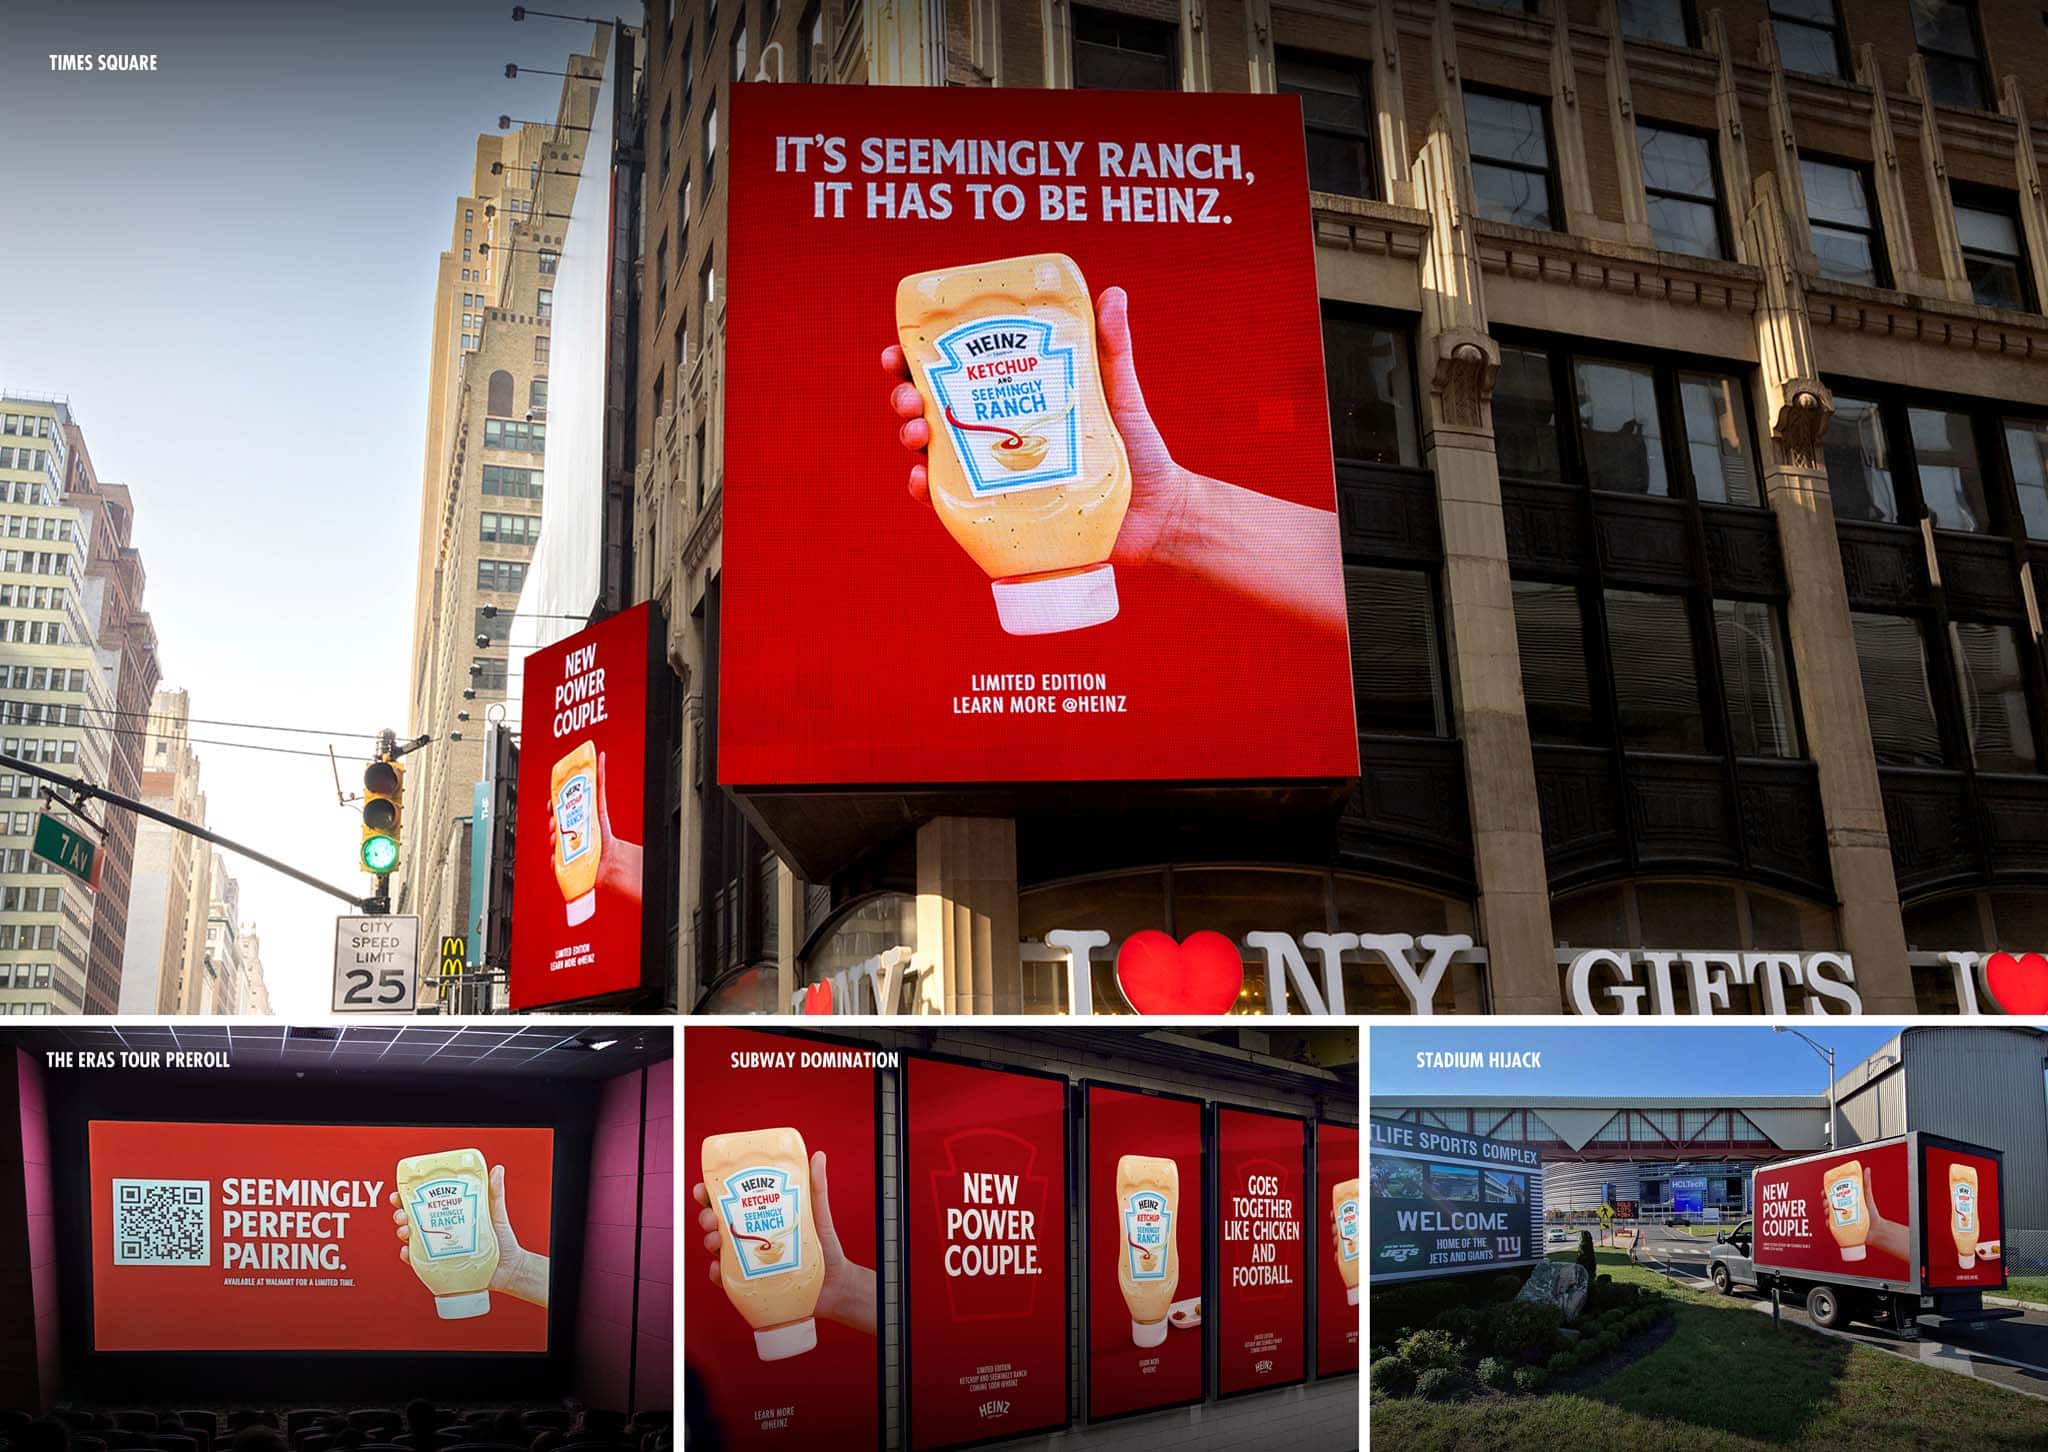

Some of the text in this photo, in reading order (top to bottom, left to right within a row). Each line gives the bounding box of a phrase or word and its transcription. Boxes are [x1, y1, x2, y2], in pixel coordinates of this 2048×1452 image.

[860, 136, 1084, 177] SEEMINGLY
[1099, 142, 1255, 185] RANCH,
[813, 181, 1233, 224] IT HAS TO BE HEINZ.
[965, 333, 1028, 357] HEINZ
[966, 356, 1039, 381] KETCHUP
[971, 379, 1043, 401] SEEMINGLY
[997, 376, 1013, 385] AND
[974, 393, 1048, 421] RANCH
[564, 642, 598, 680] NEW
[554, 667, 606, 712] POWER
[971, 673, 1106, 692] LIMITED EDITION
[953, 695, 1127, 714] LEARN MORE @HEINZ
[552, 695, 609, 739] COUPLE.
[60, 832, 89, 873] 7 AV
[360, 922, 393, 933] CITY
[351, 937, 400, 949] SPEED
[355, 952, 394, 964] LIMIT
[1246, 931, 1473, 1015] NY
[1567, 949, 1863, 1015] GIFTS
[343, 969, 406, 1005] 25
[1419, 1131, 1478, 1157] SPORTS
[1482, 1142, 1537, 1165] COMPLEX
[222, 1177, 385, 1208] SEEMINGLY
[428, 1186, 458, 1199] HEINZ
[741, 1176, 776, 1193] HEINZ
[963, 1171, 1019, 1206] NEW
[1248, 1174, 1278, 1196] GOES
[1762, 1181, 1790, 1201] NEW
[427, 1197, 463, 1209] KETCHUP
[740, 1192, 782, 1208] KETCHUP
[1138, 1199, 1160, 1210] HEINZ
[1232, 1197, 1293, 1219] TOGETHER
[1762, 1199, 1807, 1219] POWER
[222, 1210, 351, 1239] PERFECT
[430, 1215, 465, 1229] RANCH
[743, 1207, 783, 1221] SEEMINGLY
[745, 1215, 785, 1233] RANCH
[947, 1208, 1036, 1241] POWER
[1396, 1211, 1508, 1232] WELCOME
[1224, 1220, 1300, 1241] LIKE CHICKEN
[1762, 1219, 1814, 1238] COUPLE.
[1251, 1243, 1276, 1264] AND
[1380, 1247, 1420, 1261] JETS
[1436, 1237, 1487, 1250] HOME OF THE
[223, 1242, 347, 1271] PAIRING.
[944, 1244, 1043, 1277] COUPLE.
[1429, 1249, 1494, 1265] JETS AND GIANTS
[224, 1277, 356, 1287] AVAILABLE AT WALMART FOR A LIMITED TIME.
[1232, 1264, 1293, 1287] FOOTBALL.
[754, 1406, 795, 1421] LEARN MORE
[978, 1399, 1011, 1417] HEINZ
